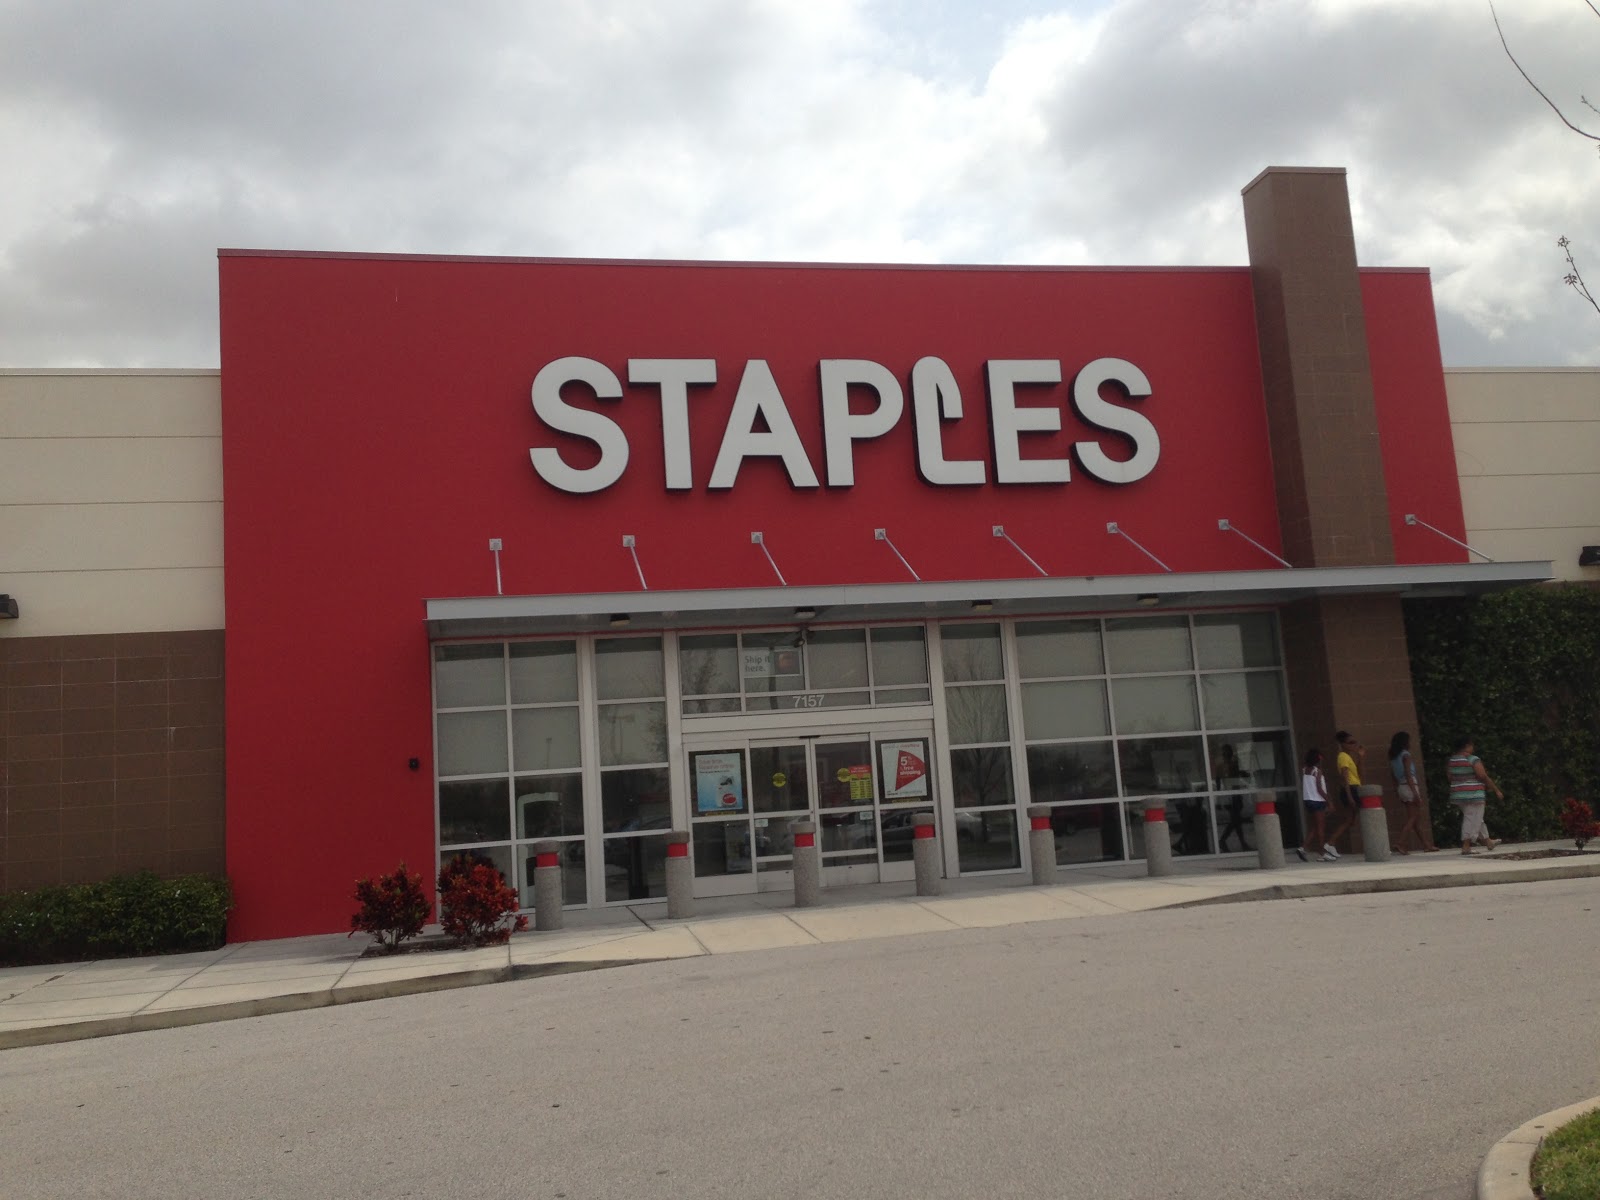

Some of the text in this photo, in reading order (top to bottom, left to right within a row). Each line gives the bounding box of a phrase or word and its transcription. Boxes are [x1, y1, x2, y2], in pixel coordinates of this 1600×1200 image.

[529, 356, 1161, 494] STAPLES
[745, 655, 762, 664] Ship
[745, 664, 766, 672] here.
[793, 695, 824, 708] 7157
